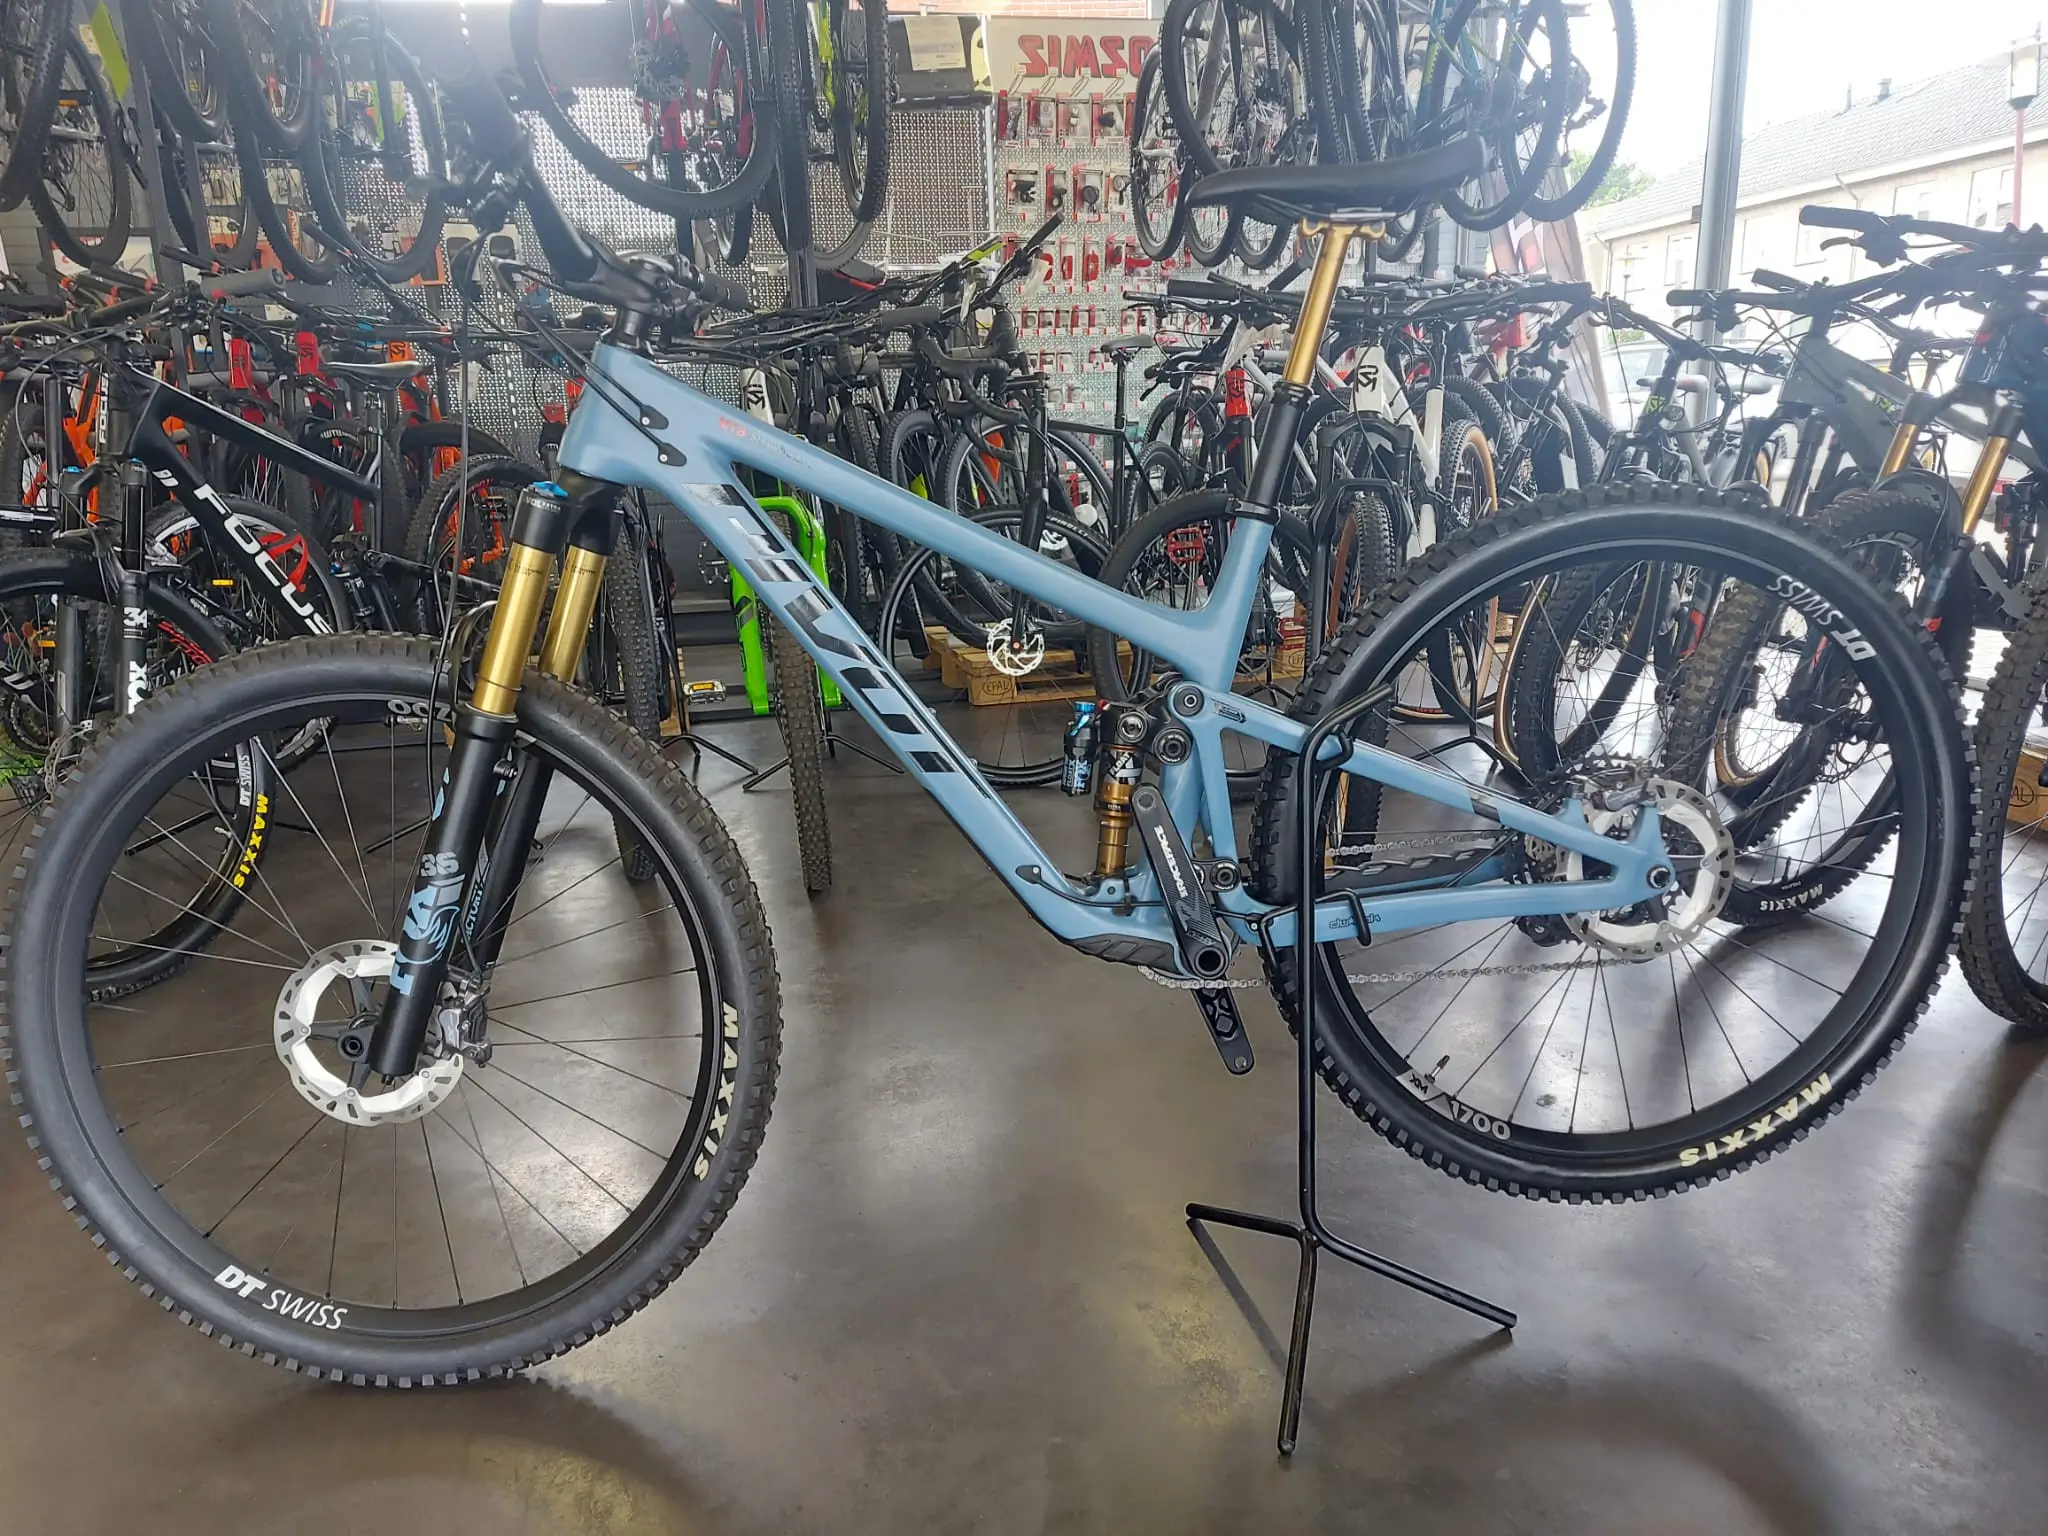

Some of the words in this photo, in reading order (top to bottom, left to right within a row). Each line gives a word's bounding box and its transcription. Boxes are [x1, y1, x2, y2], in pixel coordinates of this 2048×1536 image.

[1018, 34, 1158, 78] SIMSO
[98, 372, 109, 444] FOCUS
[193, 483, 335, 635] FOCUS
[123, 606, 148, 629] 34
[1766, 575, 1844, 626] SWISS
[681, 484, 957, 773] PIVOT
[1830, 628, 1877, 661] DT
[238, 755, 251, 788] SWISS
[2012, 783, 2029, 804] AL
[239, 788, 250, 807] DT
[233, 792, 268, 889] MAXXIS
[1760, 883, 1823, 911] MAXXIS
[693, 1000, 739, 1181] MAXXIS
[1451, 1100, 1511, 1140] 1700
[1679, 1071, 1833, 1167] MAXXIS
[213, 1264, 268, 1298] DT
[262, 1289, 349, 1330] SWISS
